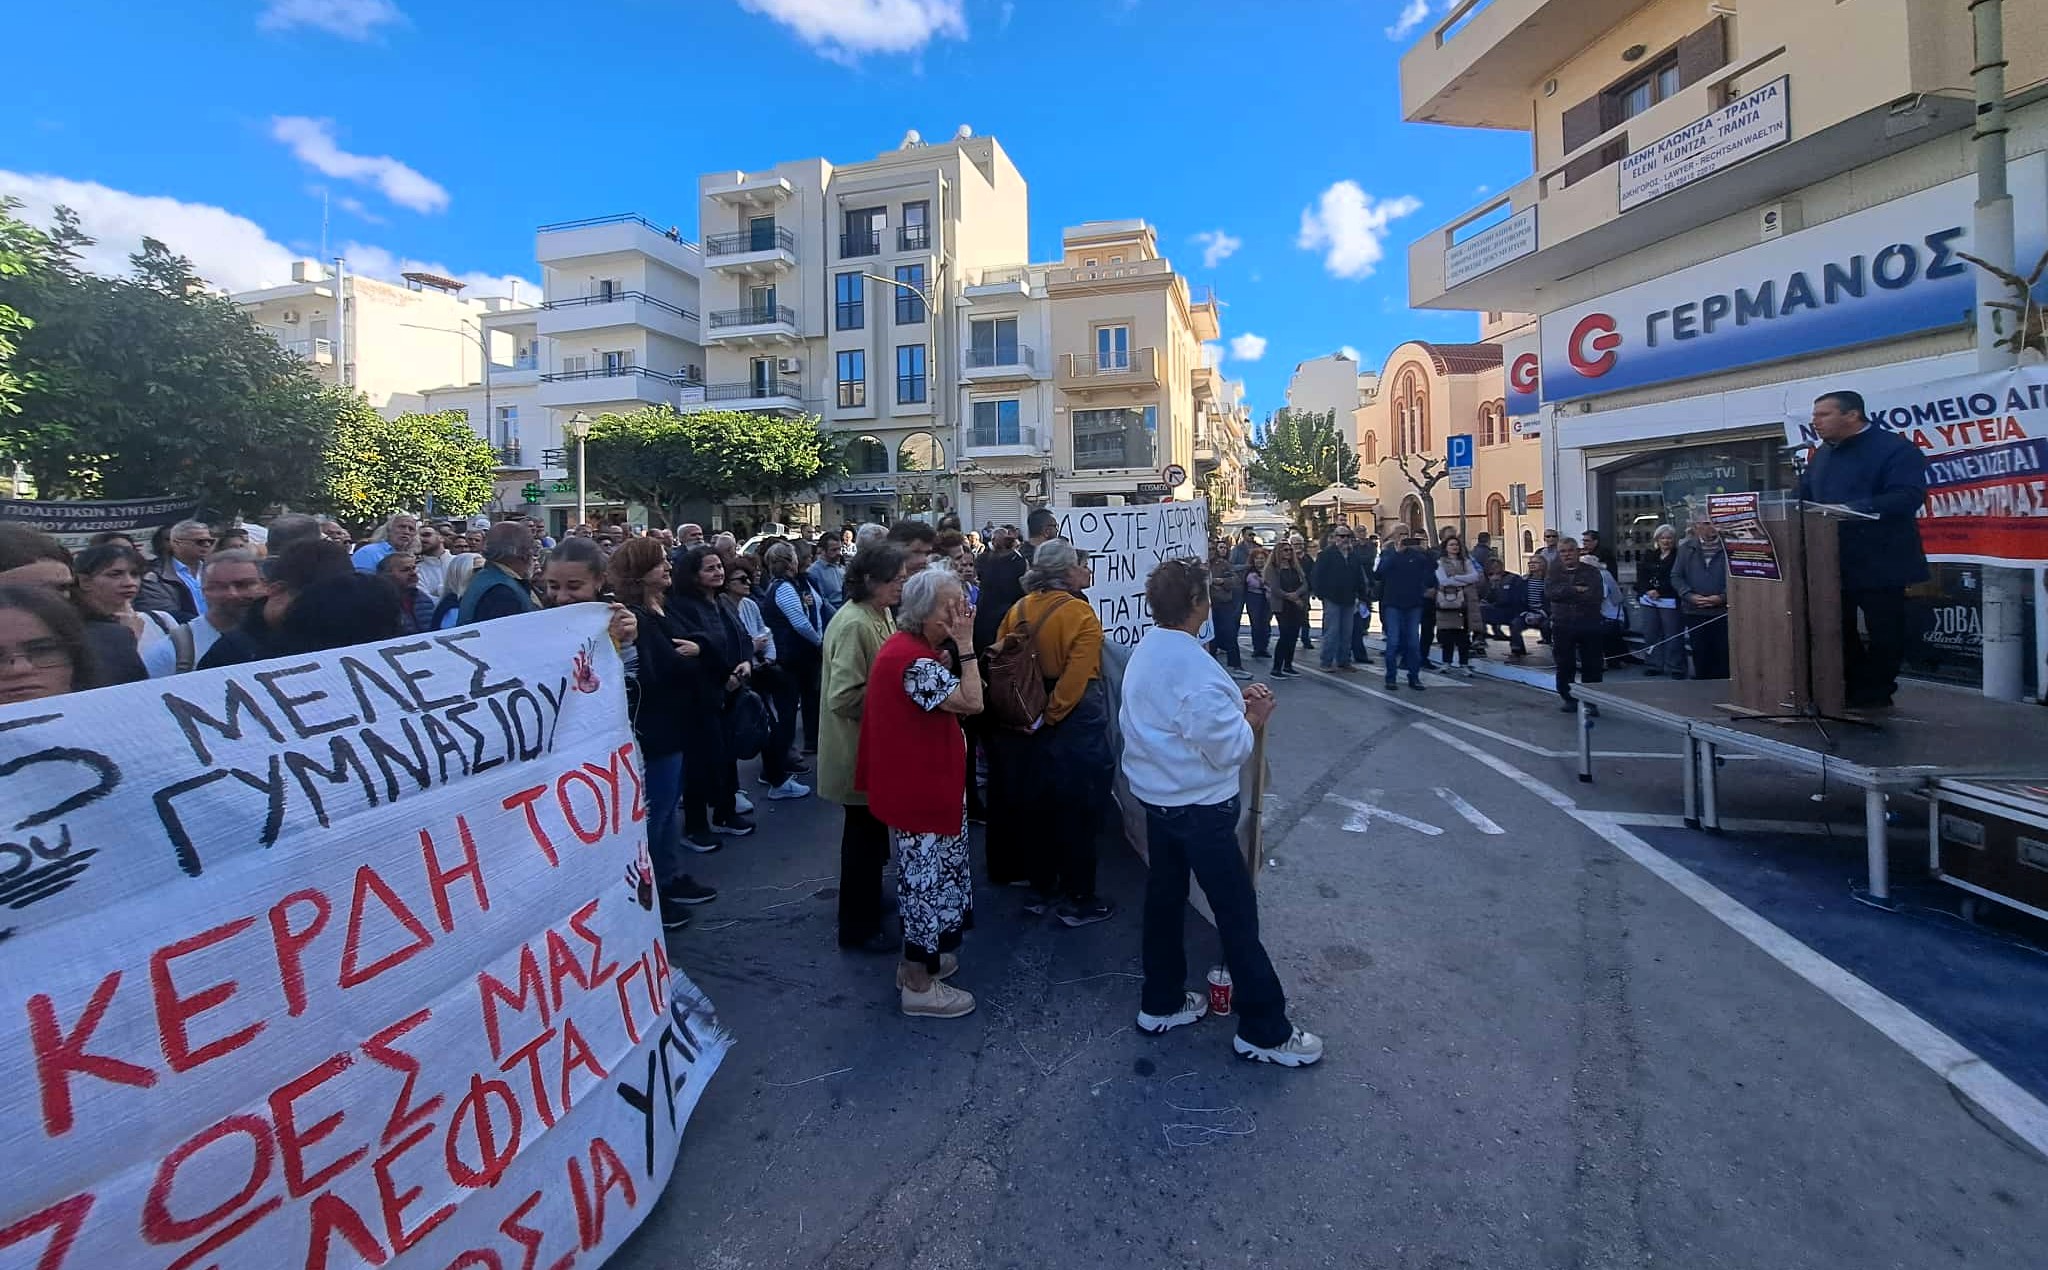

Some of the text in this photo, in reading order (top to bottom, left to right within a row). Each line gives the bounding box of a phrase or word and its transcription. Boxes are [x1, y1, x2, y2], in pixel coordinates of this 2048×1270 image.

[1623, 86, 1777, 171] ΕΛΕΝΗ ΚΛΩΝΤΖΑ ΤΡΑΝΤΑ
[1632, 110, 1760, 179] ELENI KLONTZA TRANTA
[1664, 161, 1694, 182] LAWYER
[1646, 227, 1968, 348] ΓΕΡΜΑΝΟΣ
[1453, 438, 1465, 467] P
[1936, 415, 2027, 447] ΥΓΕΙΑ
[161, 630, 522, 767] ΜΕΛΕΣ
[152, 677, 568, 877] ΓΥΜΝΑΣΙΟΥ
[27, 742, 646, 1137] ΚΕΡΔΗ ΤΟΥΣ
[478, 899, 619, 1061] ΜΑΣ
